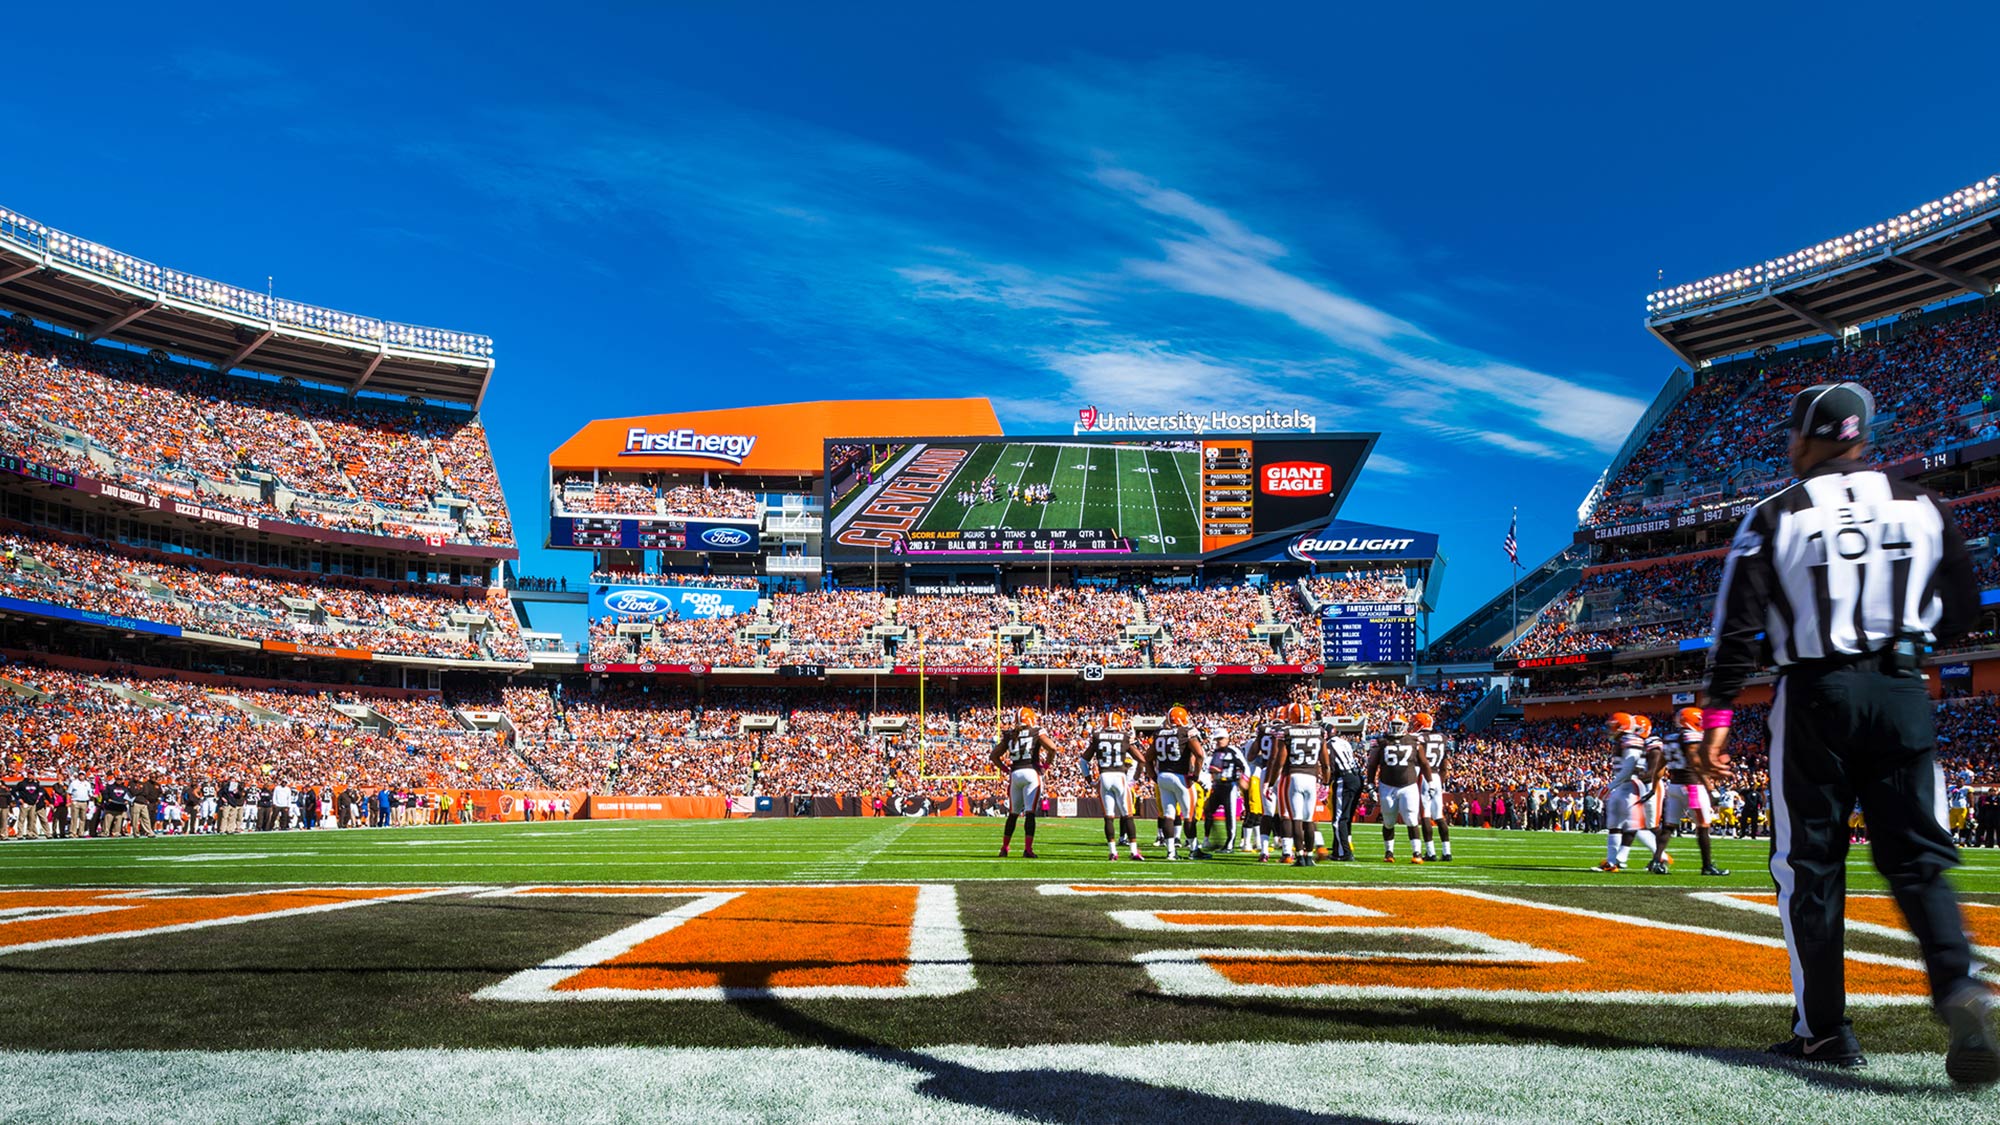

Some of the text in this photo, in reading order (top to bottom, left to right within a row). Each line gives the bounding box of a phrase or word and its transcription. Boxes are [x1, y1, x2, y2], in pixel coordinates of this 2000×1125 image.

[1099, 409, 1310, 434] University Hospitals
[626, 427, 757, 457] FirstEnergy
[1922, 453, 1946, 469] 7:14
[1267, 467, 1325, 479] GIANT
[1268, 479, 1324, 491] EAGLE
[101, 483, 119, 497] LOU
[119, 487, 145, 504] GROZA
[148, 495, 160, 508] 76
[837, 448, 968, 547] CLEVELAND
[175, 503, 259, 529] OZZIE NEWSOME 82
[1594, 504, 1751, 540] CHAMPIONSHIPS 1946 1947 1948
[711, 530, 741, 544] Ford
[911, 531, 935, 539] SCORE
[937, 531, 960, 539] ALERT
[909, 541, 922, 550] 2ND
[948, 541, 965, 550] BALL
[967, 541, 977, 550] ON
[979, 540, 987, 550] 31
[1002, 541, 1013, 550] PIT
[1034, 540, 1047, 549] CLE
[1063, 540, 1077, 549] 7:14
[1092, 540, 1106, 549] QTR
[915, 586, 995, 594] 100% DAWG POUND
[617, 593, 658, 612] Ford
[681, 593, 721, 605] FORD
[693, 604, 734, 615] ZONE
[1346, 604, 1373, 612] FANTASY
[107, 615, 136, 630] Surface
[1518, 654, 1586, 668] GIANT EAGLE
[796, 665, 817, 676] 7:14
[1087, 667, 1100, 677] 25
[1098, 741, 1123, 767] 31
[1155, 736, 1181, 761] 93
[1289, 738, 1321, 765] 53
[1384, 745, 1413, 766] 67
[1426, 743, 1445, 767] 51
[203, 786, 216, 797] 99
